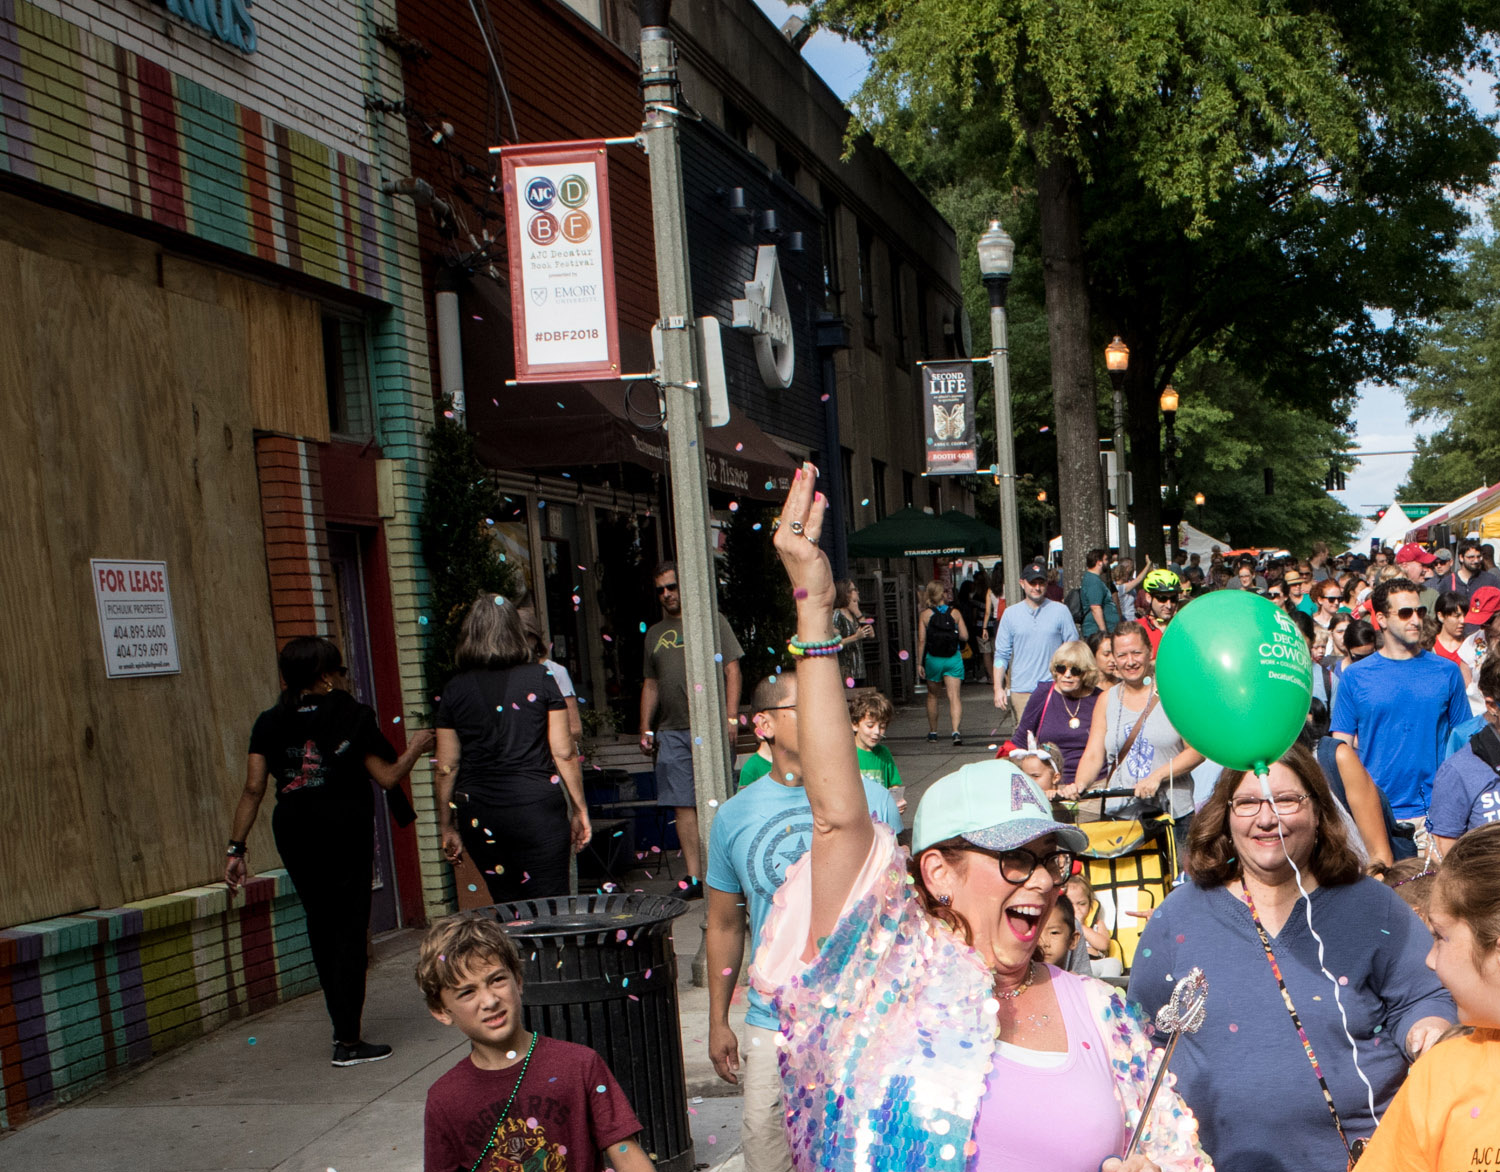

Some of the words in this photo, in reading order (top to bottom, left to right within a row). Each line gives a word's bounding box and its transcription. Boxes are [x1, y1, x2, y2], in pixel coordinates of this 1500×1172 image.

[530, 187, 554, 203] AJC
[566, 181, 583, 202] D
[537, 218, 552, 239] B
[569, 216, 583, 236] F
[530, 250, 548, 260] AJC
[551, 249, 593, 259] Decatur
[531, 262, 552, 270] Book
[554, 260, 595, 269] Festival
[554, 284, 597, 298] EMORY
[535, 328, 599, 342] #DBF2018
[931, 372, 964, 381] SECOND
[930, 379, 967, 394] LIFE
[98, 569, 127, 592] FOR
[128, 570, 165, 592] LEASE
[133, 604, 164, 614] PROPERTIES
[113, 625, 166, 639] 404.895.6600
[117, 643, 168, 658] 404.759.6979
[1011, 773, 1047, 814] A
[1471, 1147, 1493, 1166] AJC
